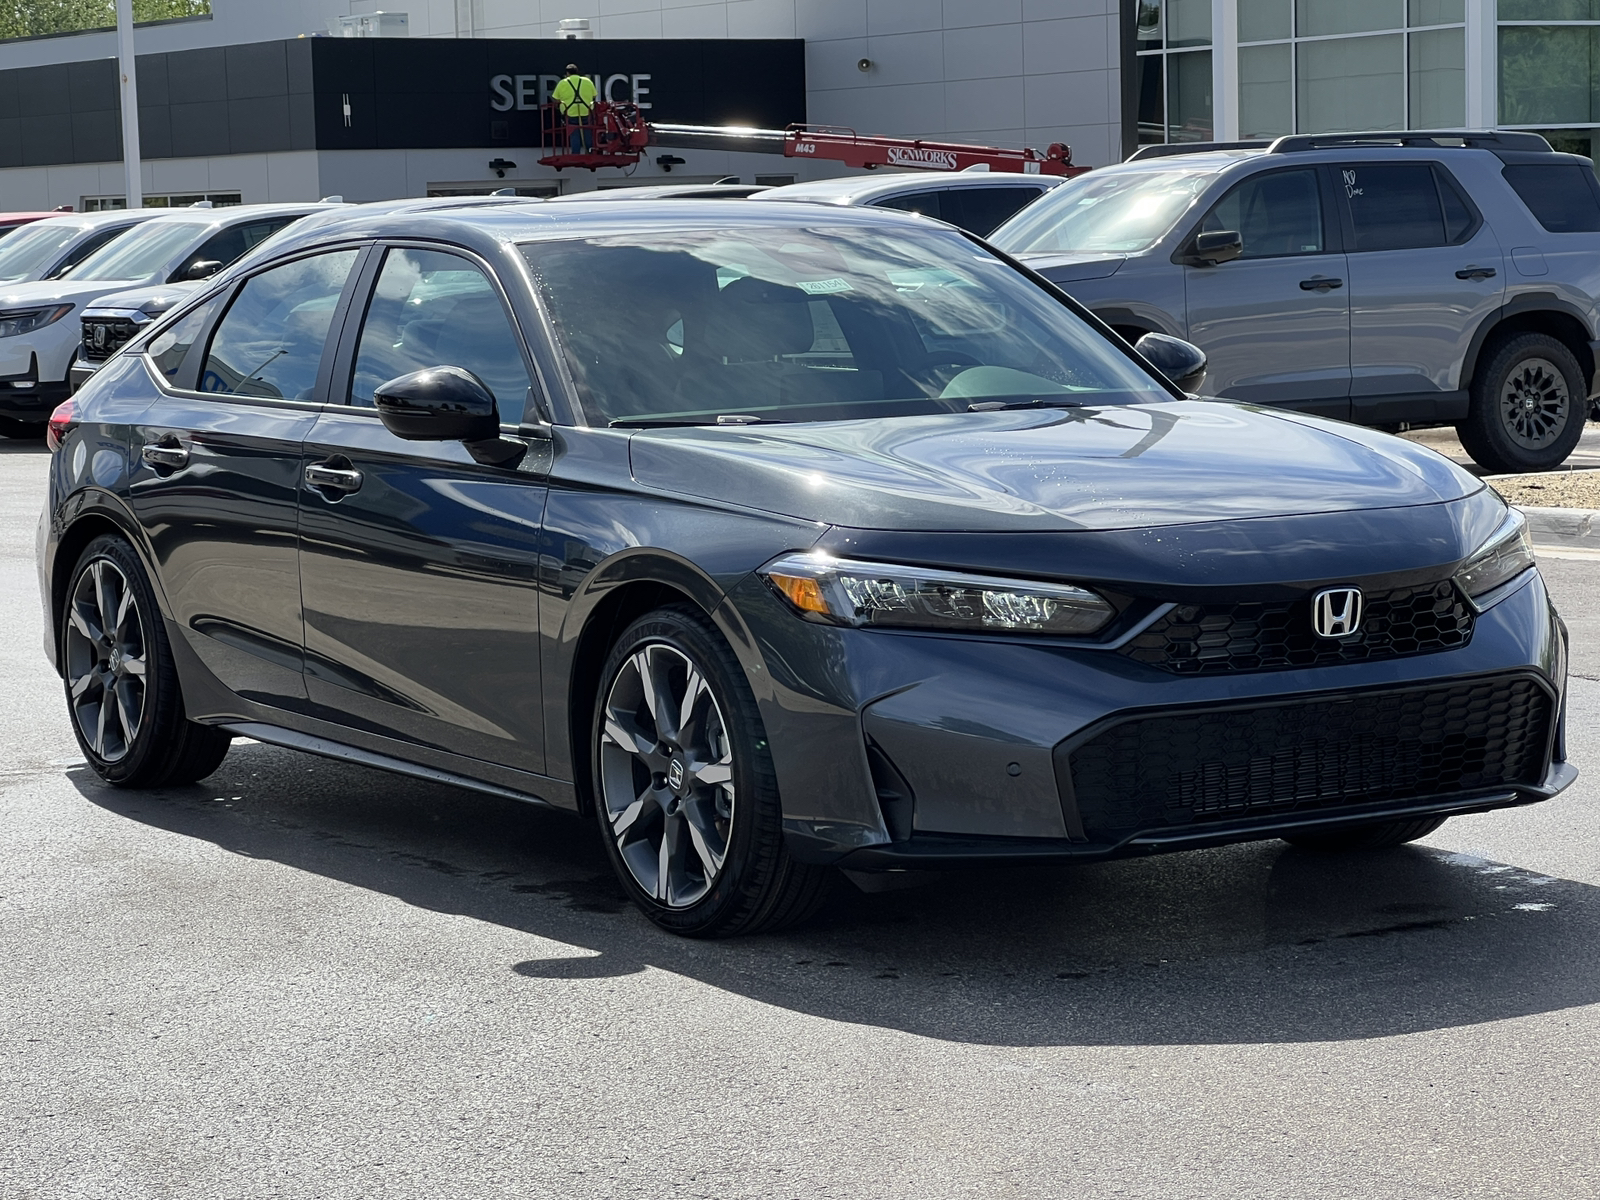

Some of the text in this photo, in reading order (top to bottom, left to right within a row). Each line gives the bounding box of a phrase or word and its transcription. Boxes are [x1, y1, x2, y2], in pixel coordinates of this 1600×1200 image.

[490, 73, 653, 111] SERICE
[795, 143, 816, 154] M43
[887, 147, 957, 170] SIGNWORKS
